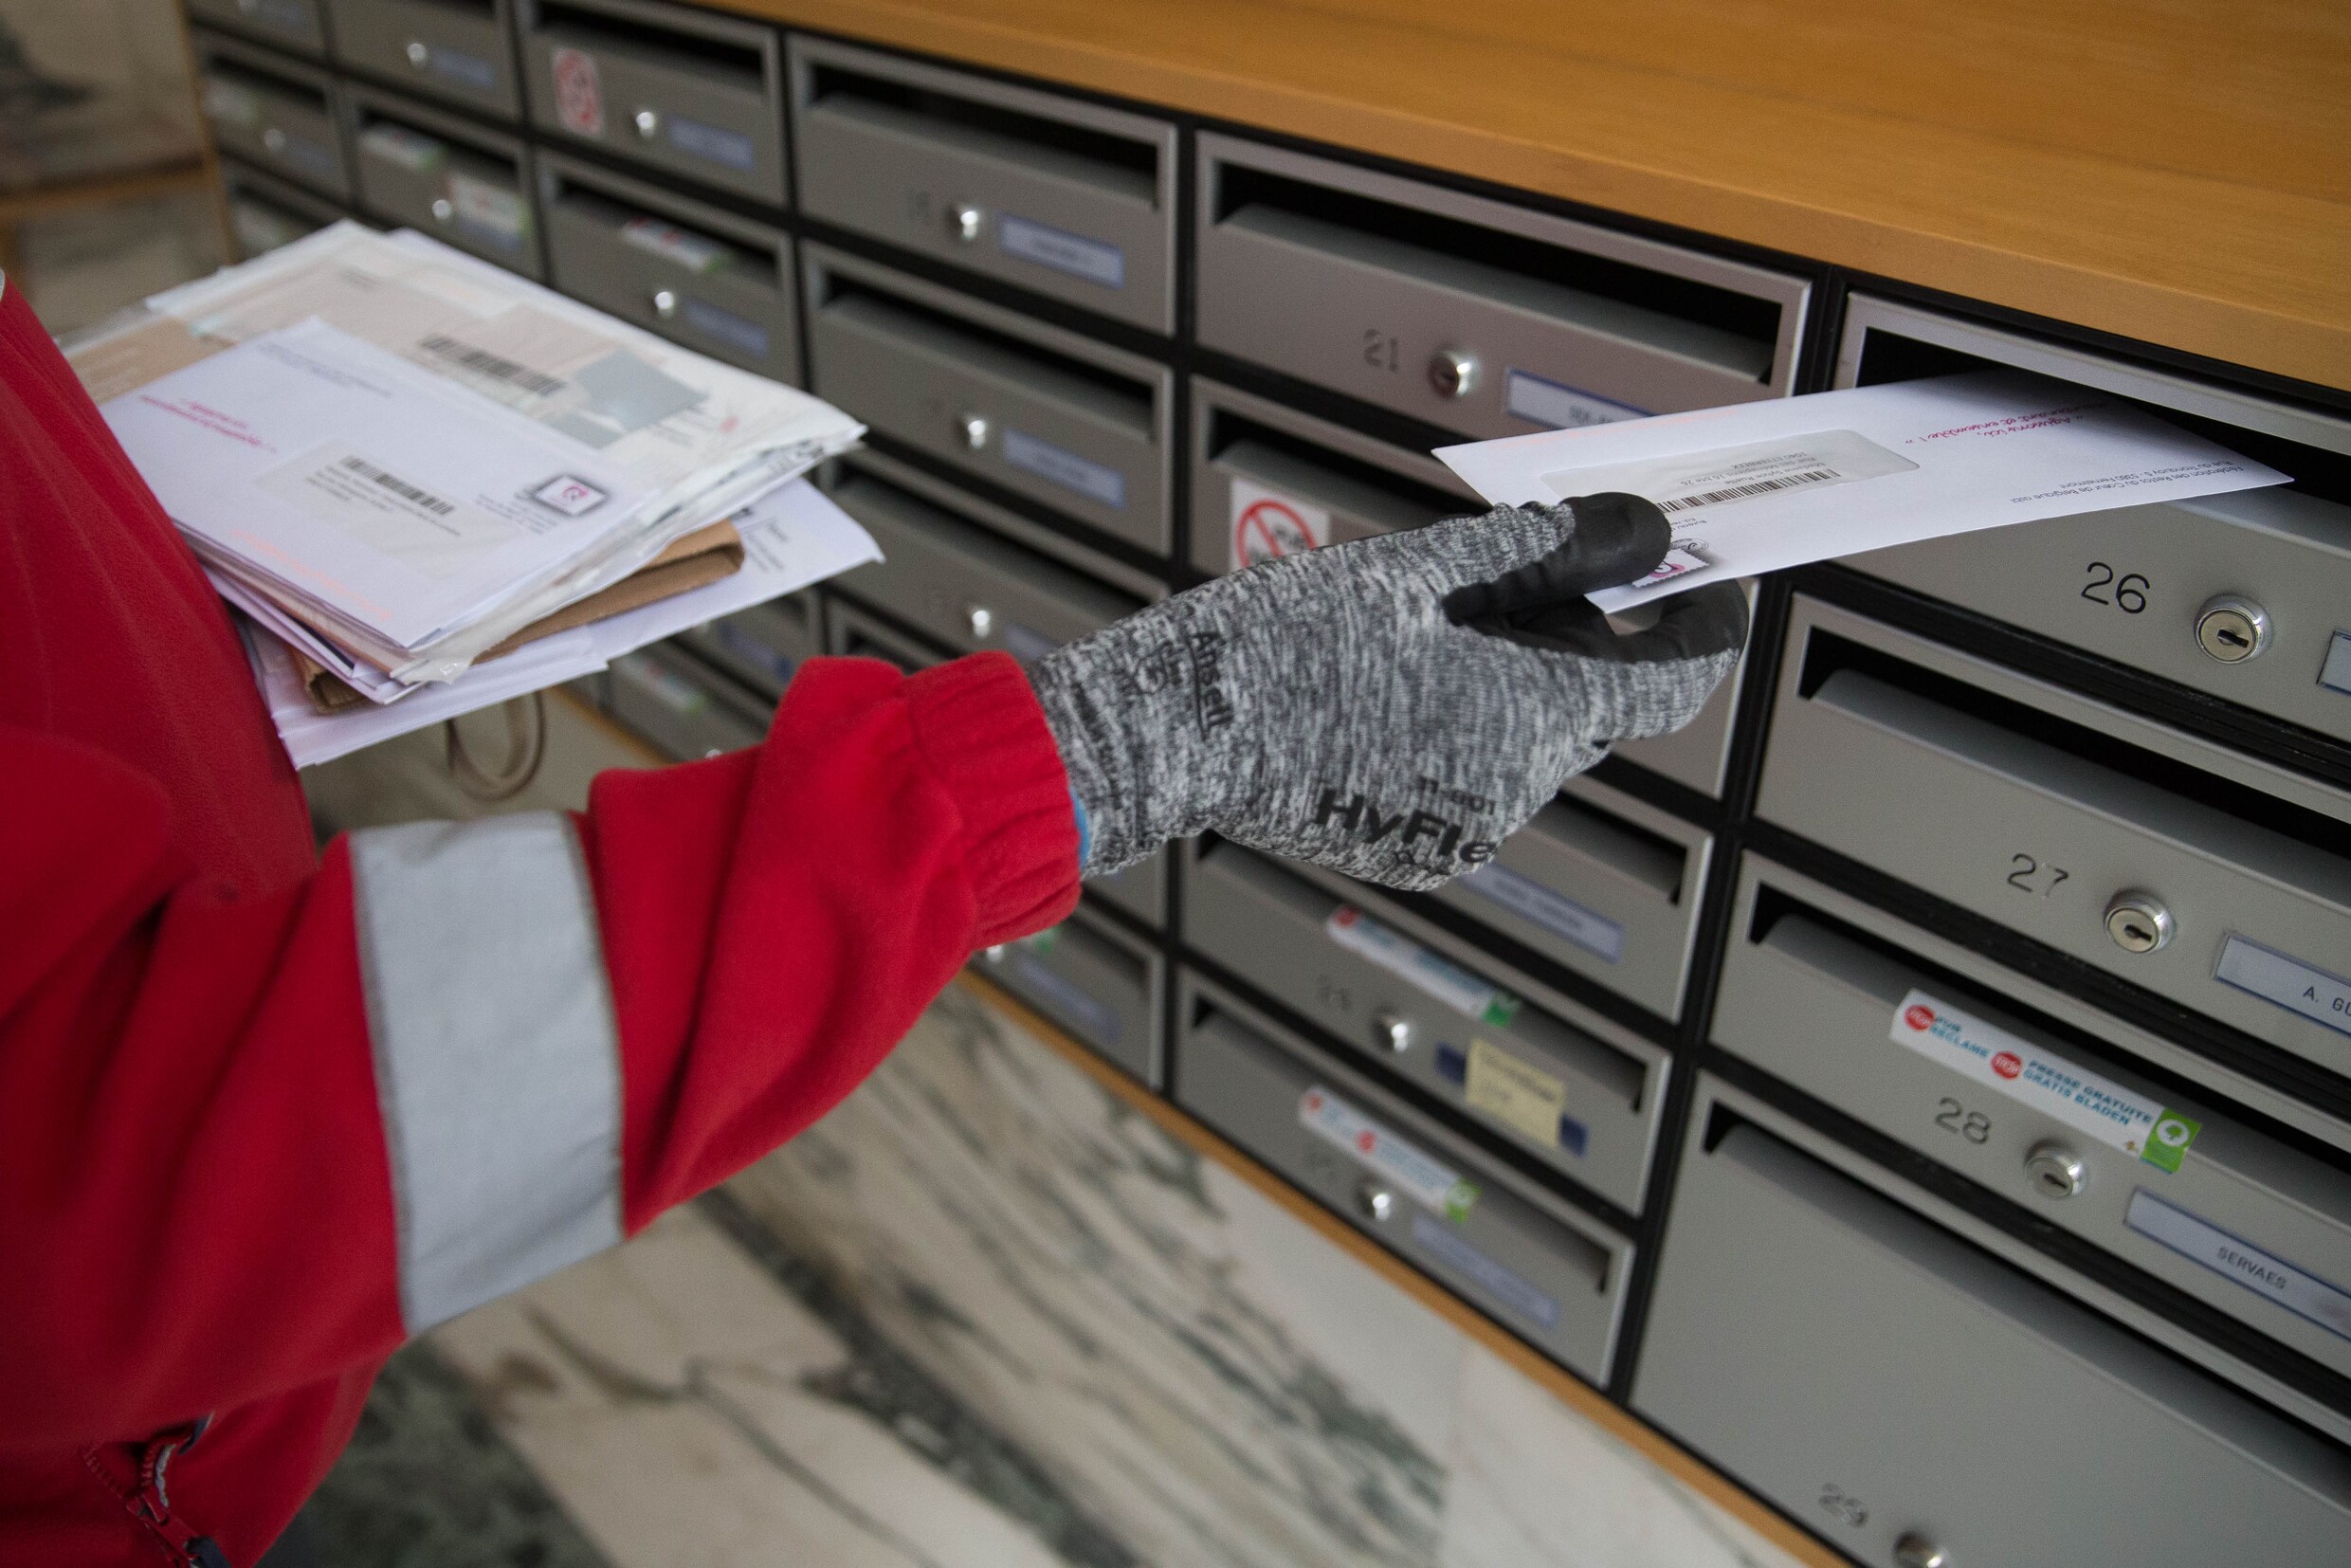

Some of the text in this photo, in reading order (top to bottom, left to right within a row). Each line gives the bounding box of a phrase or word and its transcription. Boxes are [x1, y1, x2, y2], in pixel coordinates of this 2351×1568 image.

[2081, 561, 2150, 614] 26
[1193, 630, 1234, 729] Ansell
[1316, 787, 1498, 863] HyFle
[2007, 853, 2069, 898] 27
[2302, 986, 2319, 1003] A.
[1994, 1055, 2153, 1125] STOP PRESSE GRATUITE
[2023, 1069, 2130, 1126] GRATIS BLADEN
[1934, 1097, 1991, 1145] 28
[2216, 1246, 2287, 1290] SERVAES
